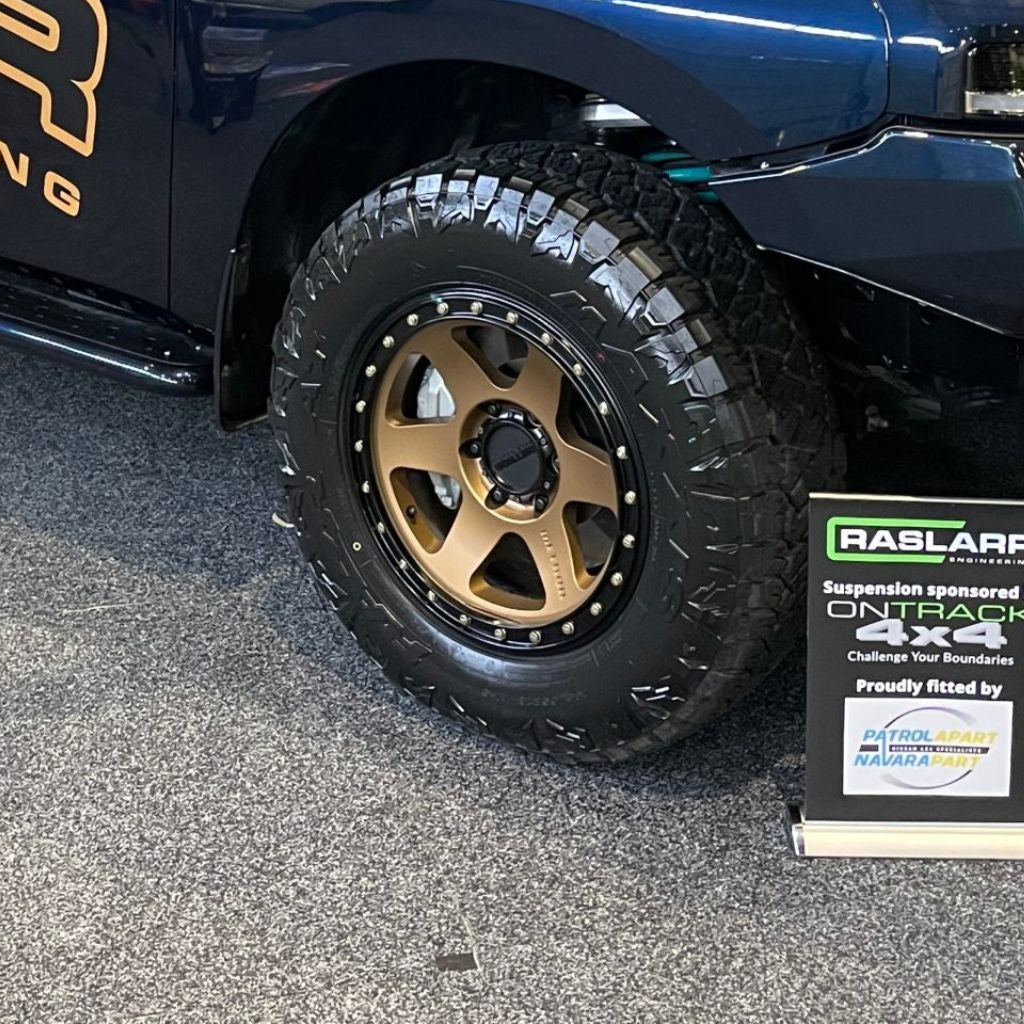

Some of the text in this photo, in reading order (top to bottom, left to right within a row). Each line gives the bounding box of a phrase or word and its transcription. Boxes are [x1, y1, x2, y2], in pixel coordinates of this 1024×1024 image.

[823, 580, 1020, 600] Suspension sponsored
[827, 600, 1024, 622] ONTRACK
[855, 618, 1007, 649] 4x4
[847, 650, 1014, 666] Challenge Your Boundaries
[856, 678, 1003, 699] Proudly fitted by
